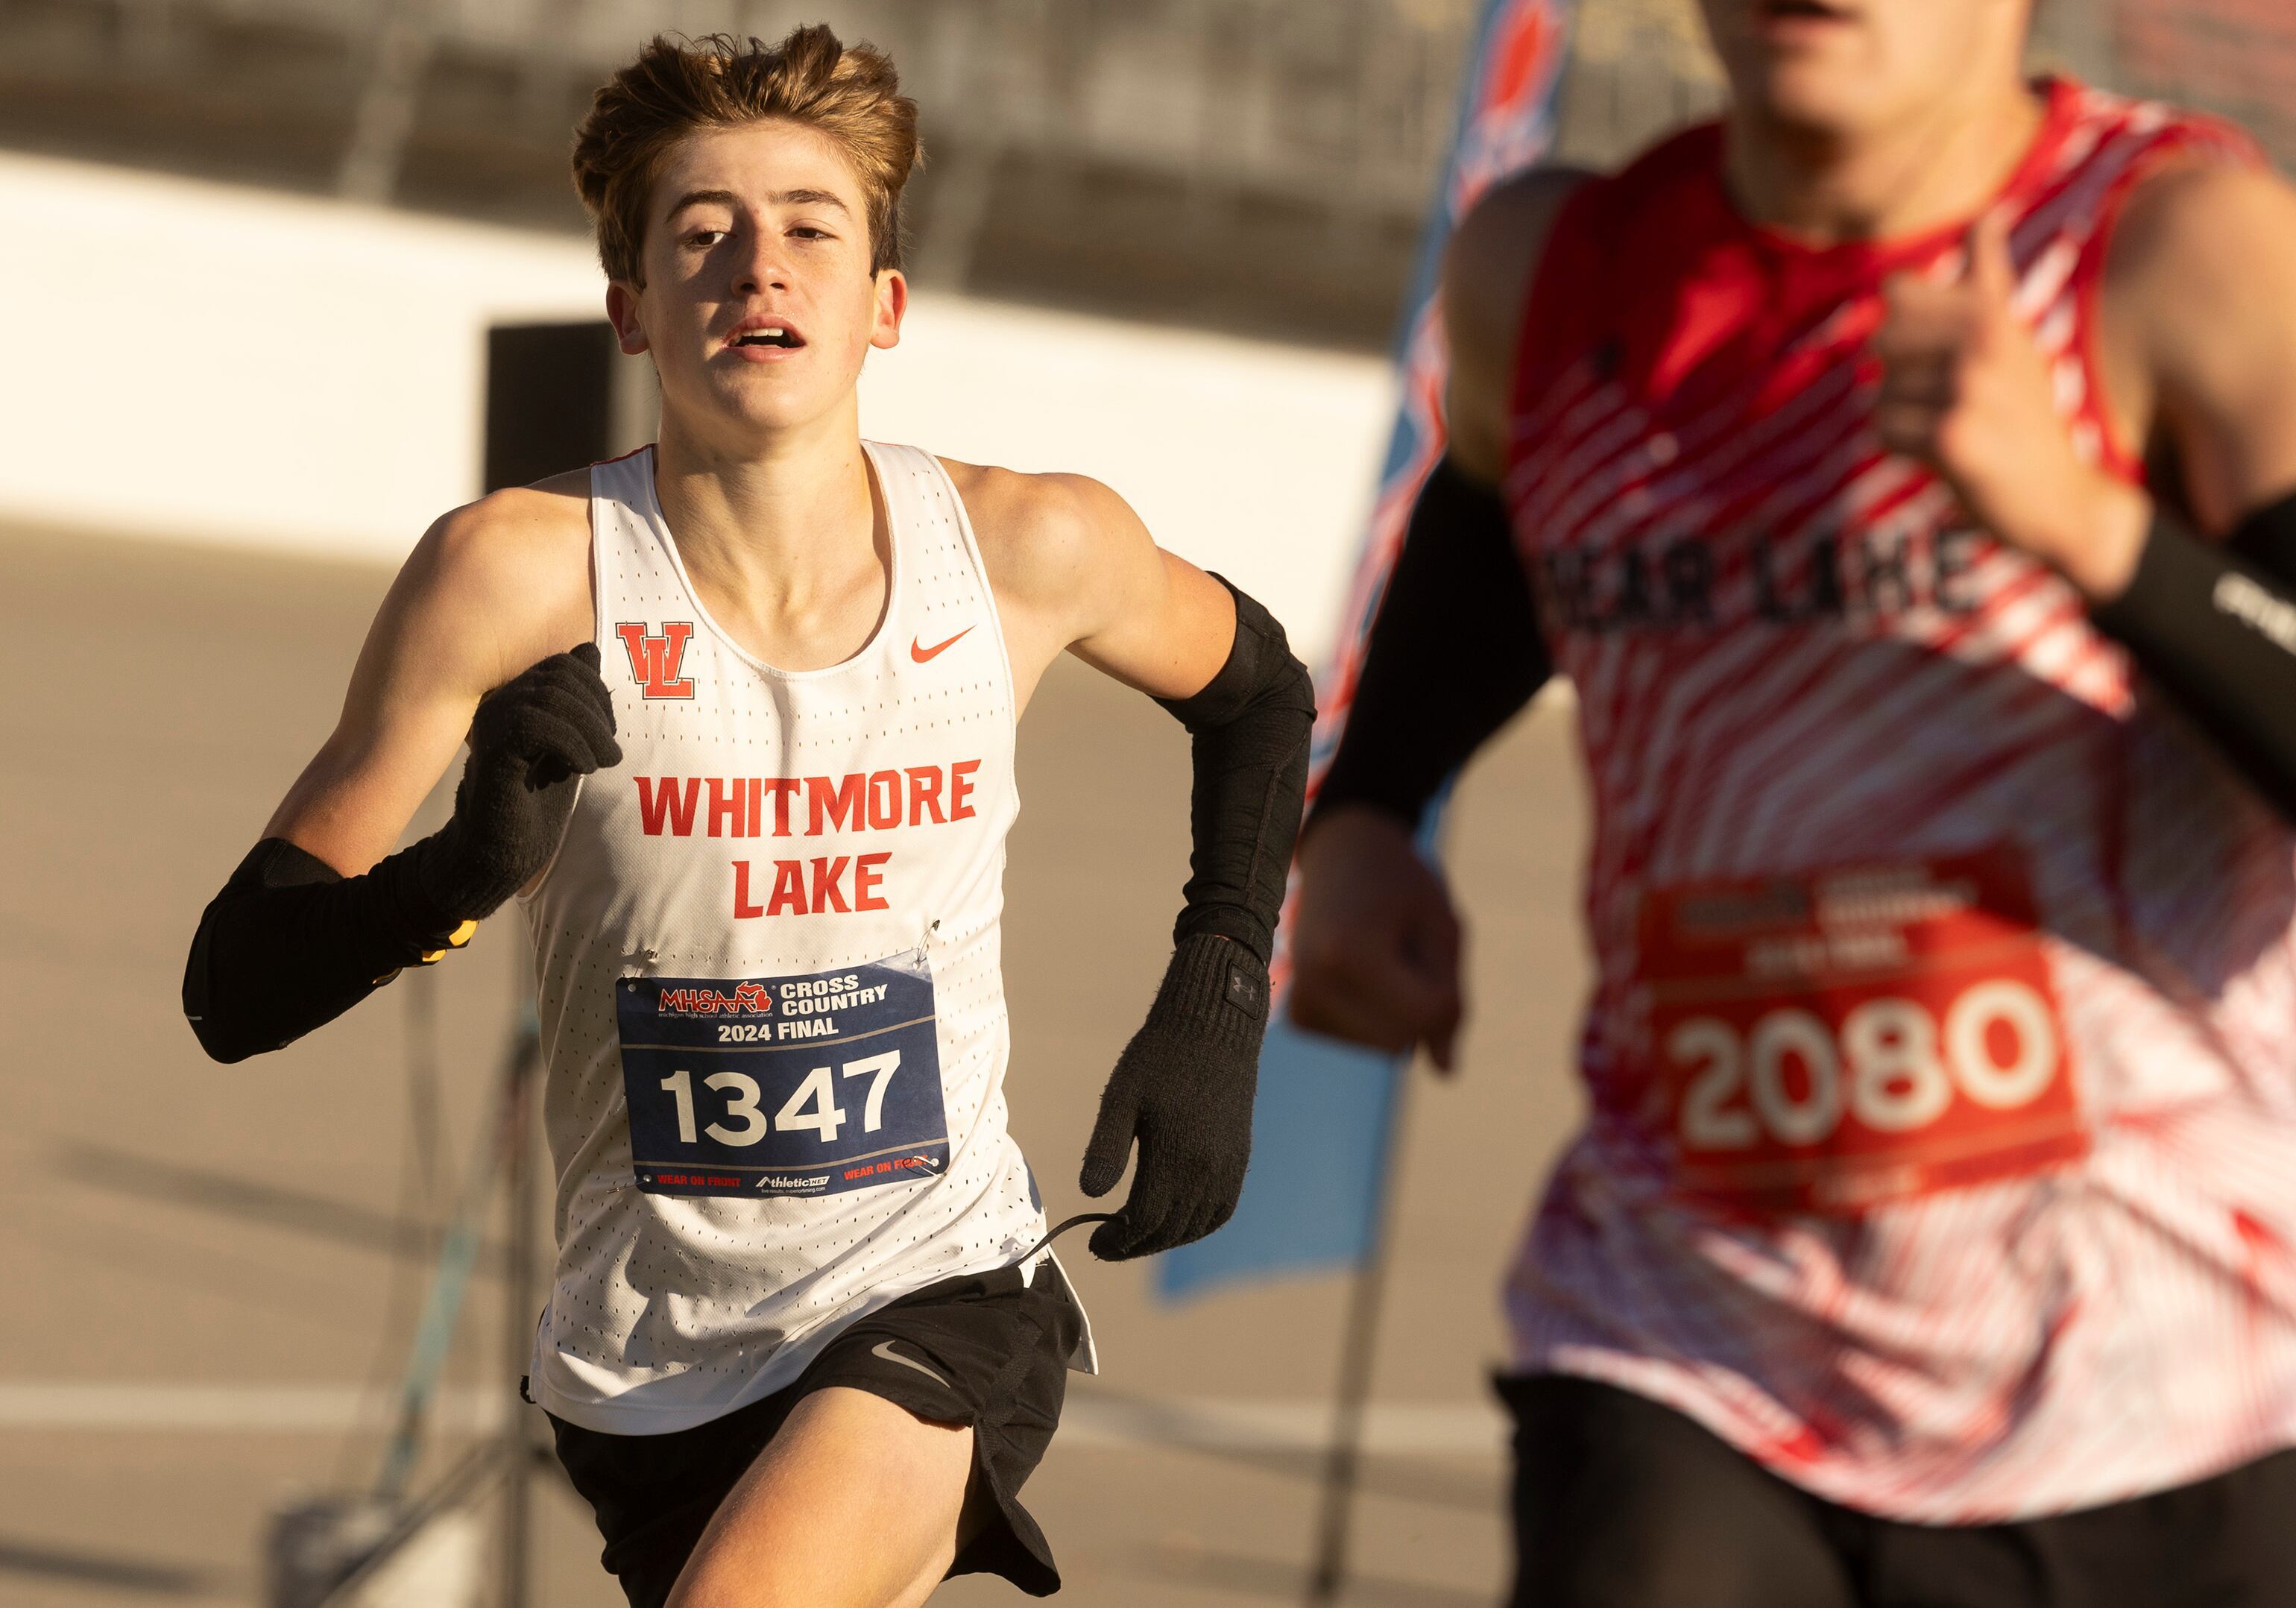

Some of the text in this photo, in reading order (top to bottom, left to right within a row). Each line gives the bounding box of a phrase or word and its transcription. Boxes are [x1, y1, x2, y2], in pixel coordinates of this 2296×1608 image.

[633, 759, 981, 838] WHITMORE
[731, 852, 892, 919] LAKE
[658, 989, 757, 1013] MHSAA
[780, 974, 859, 1000] CROSS
[781, 984, 888, 1016] COUNTRY
[718, 1018, 839, 1042] 2024 FINAL
[1668, 977, 2057, 1150] 2080
[660, 1049, 901, 1147] 1347
[657, 1174, 740, 1187] WEAR ON FRONT
[844, 1165, 874, 1180] WEAR
[877, 1161, 891, 1173] ON
